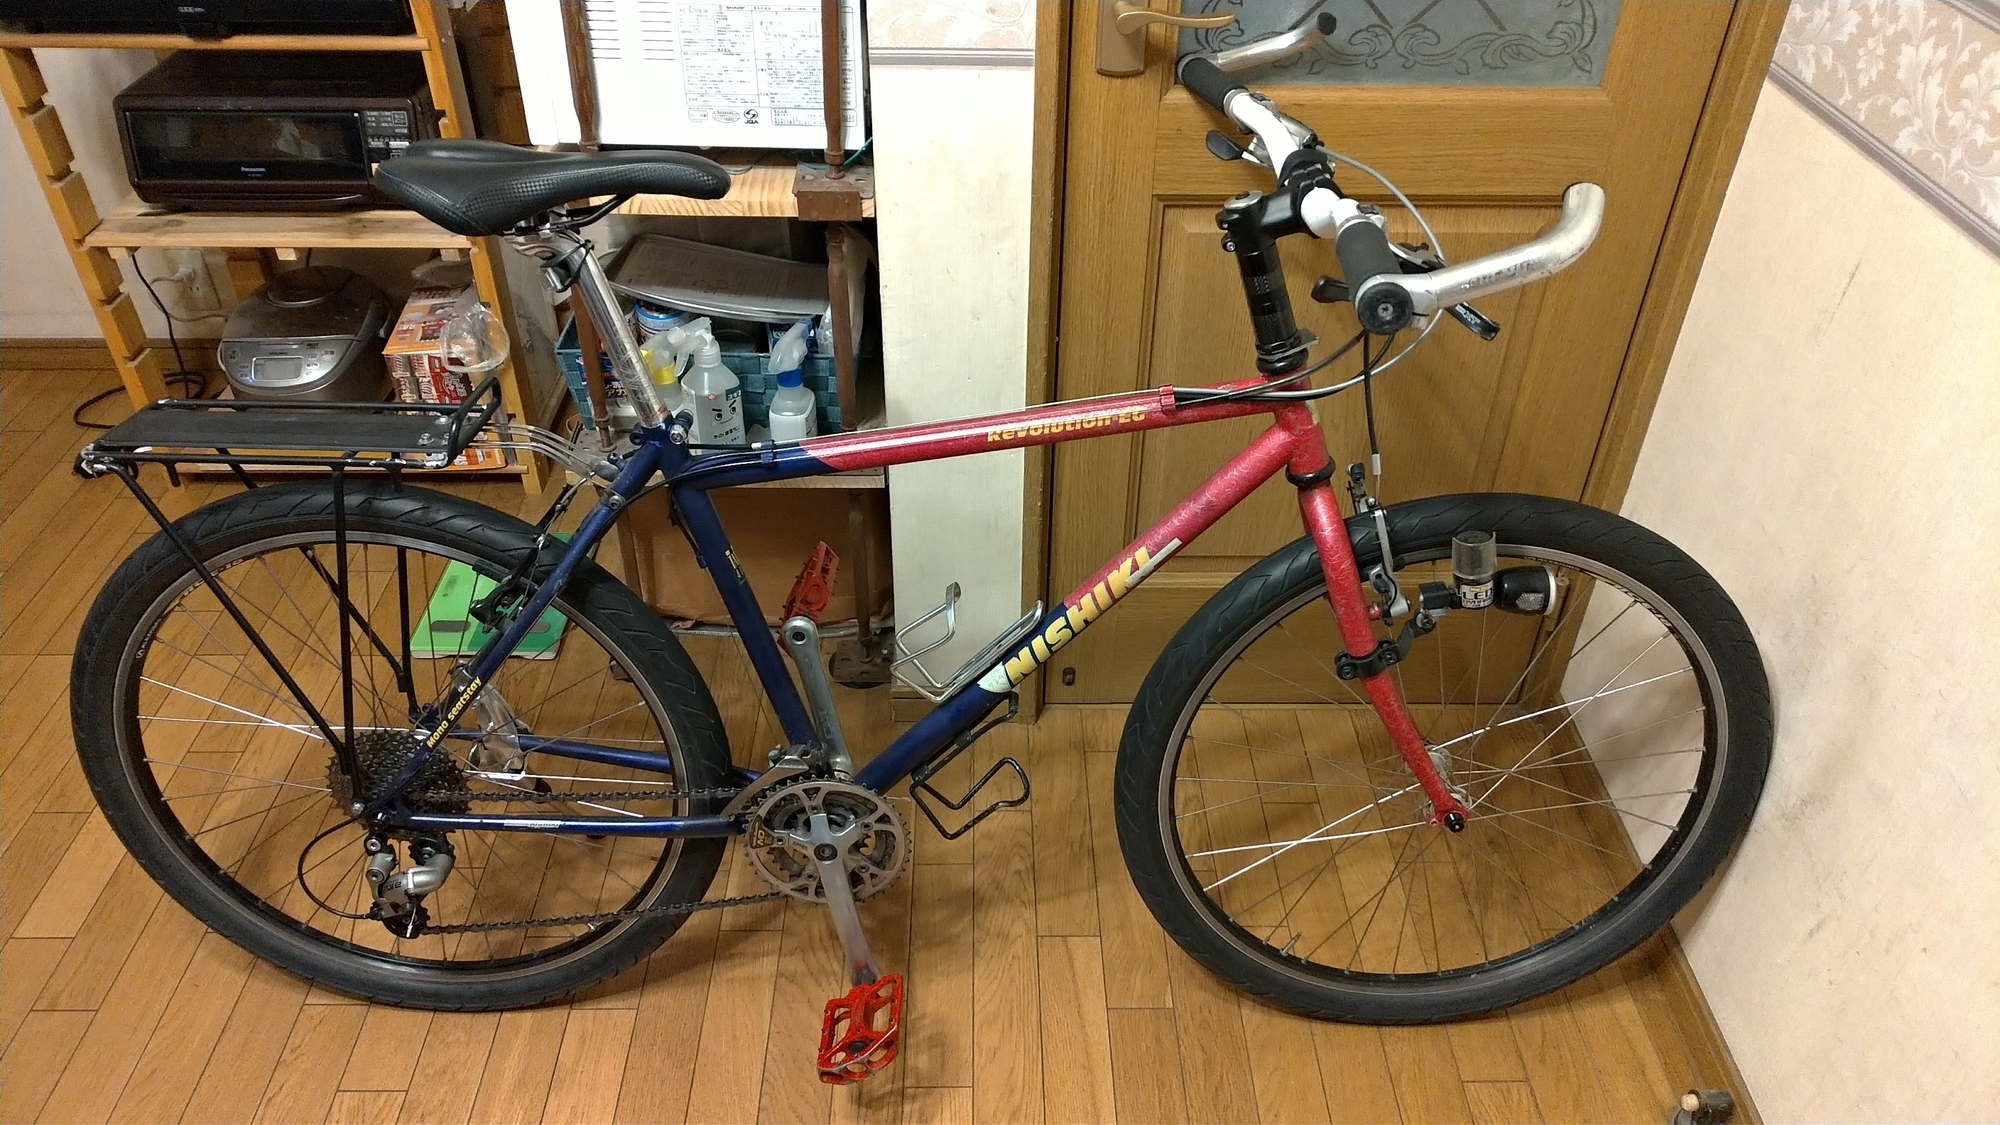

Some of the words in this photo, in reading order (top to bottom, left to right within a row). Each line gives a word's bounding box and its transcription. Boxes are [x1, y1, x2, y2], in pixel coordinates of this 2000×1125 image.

[1004, 546, 1151, 686] NISHIKI
[426, 720, 449, 748] Mono
[447, 676, 482, 721] seatstay
